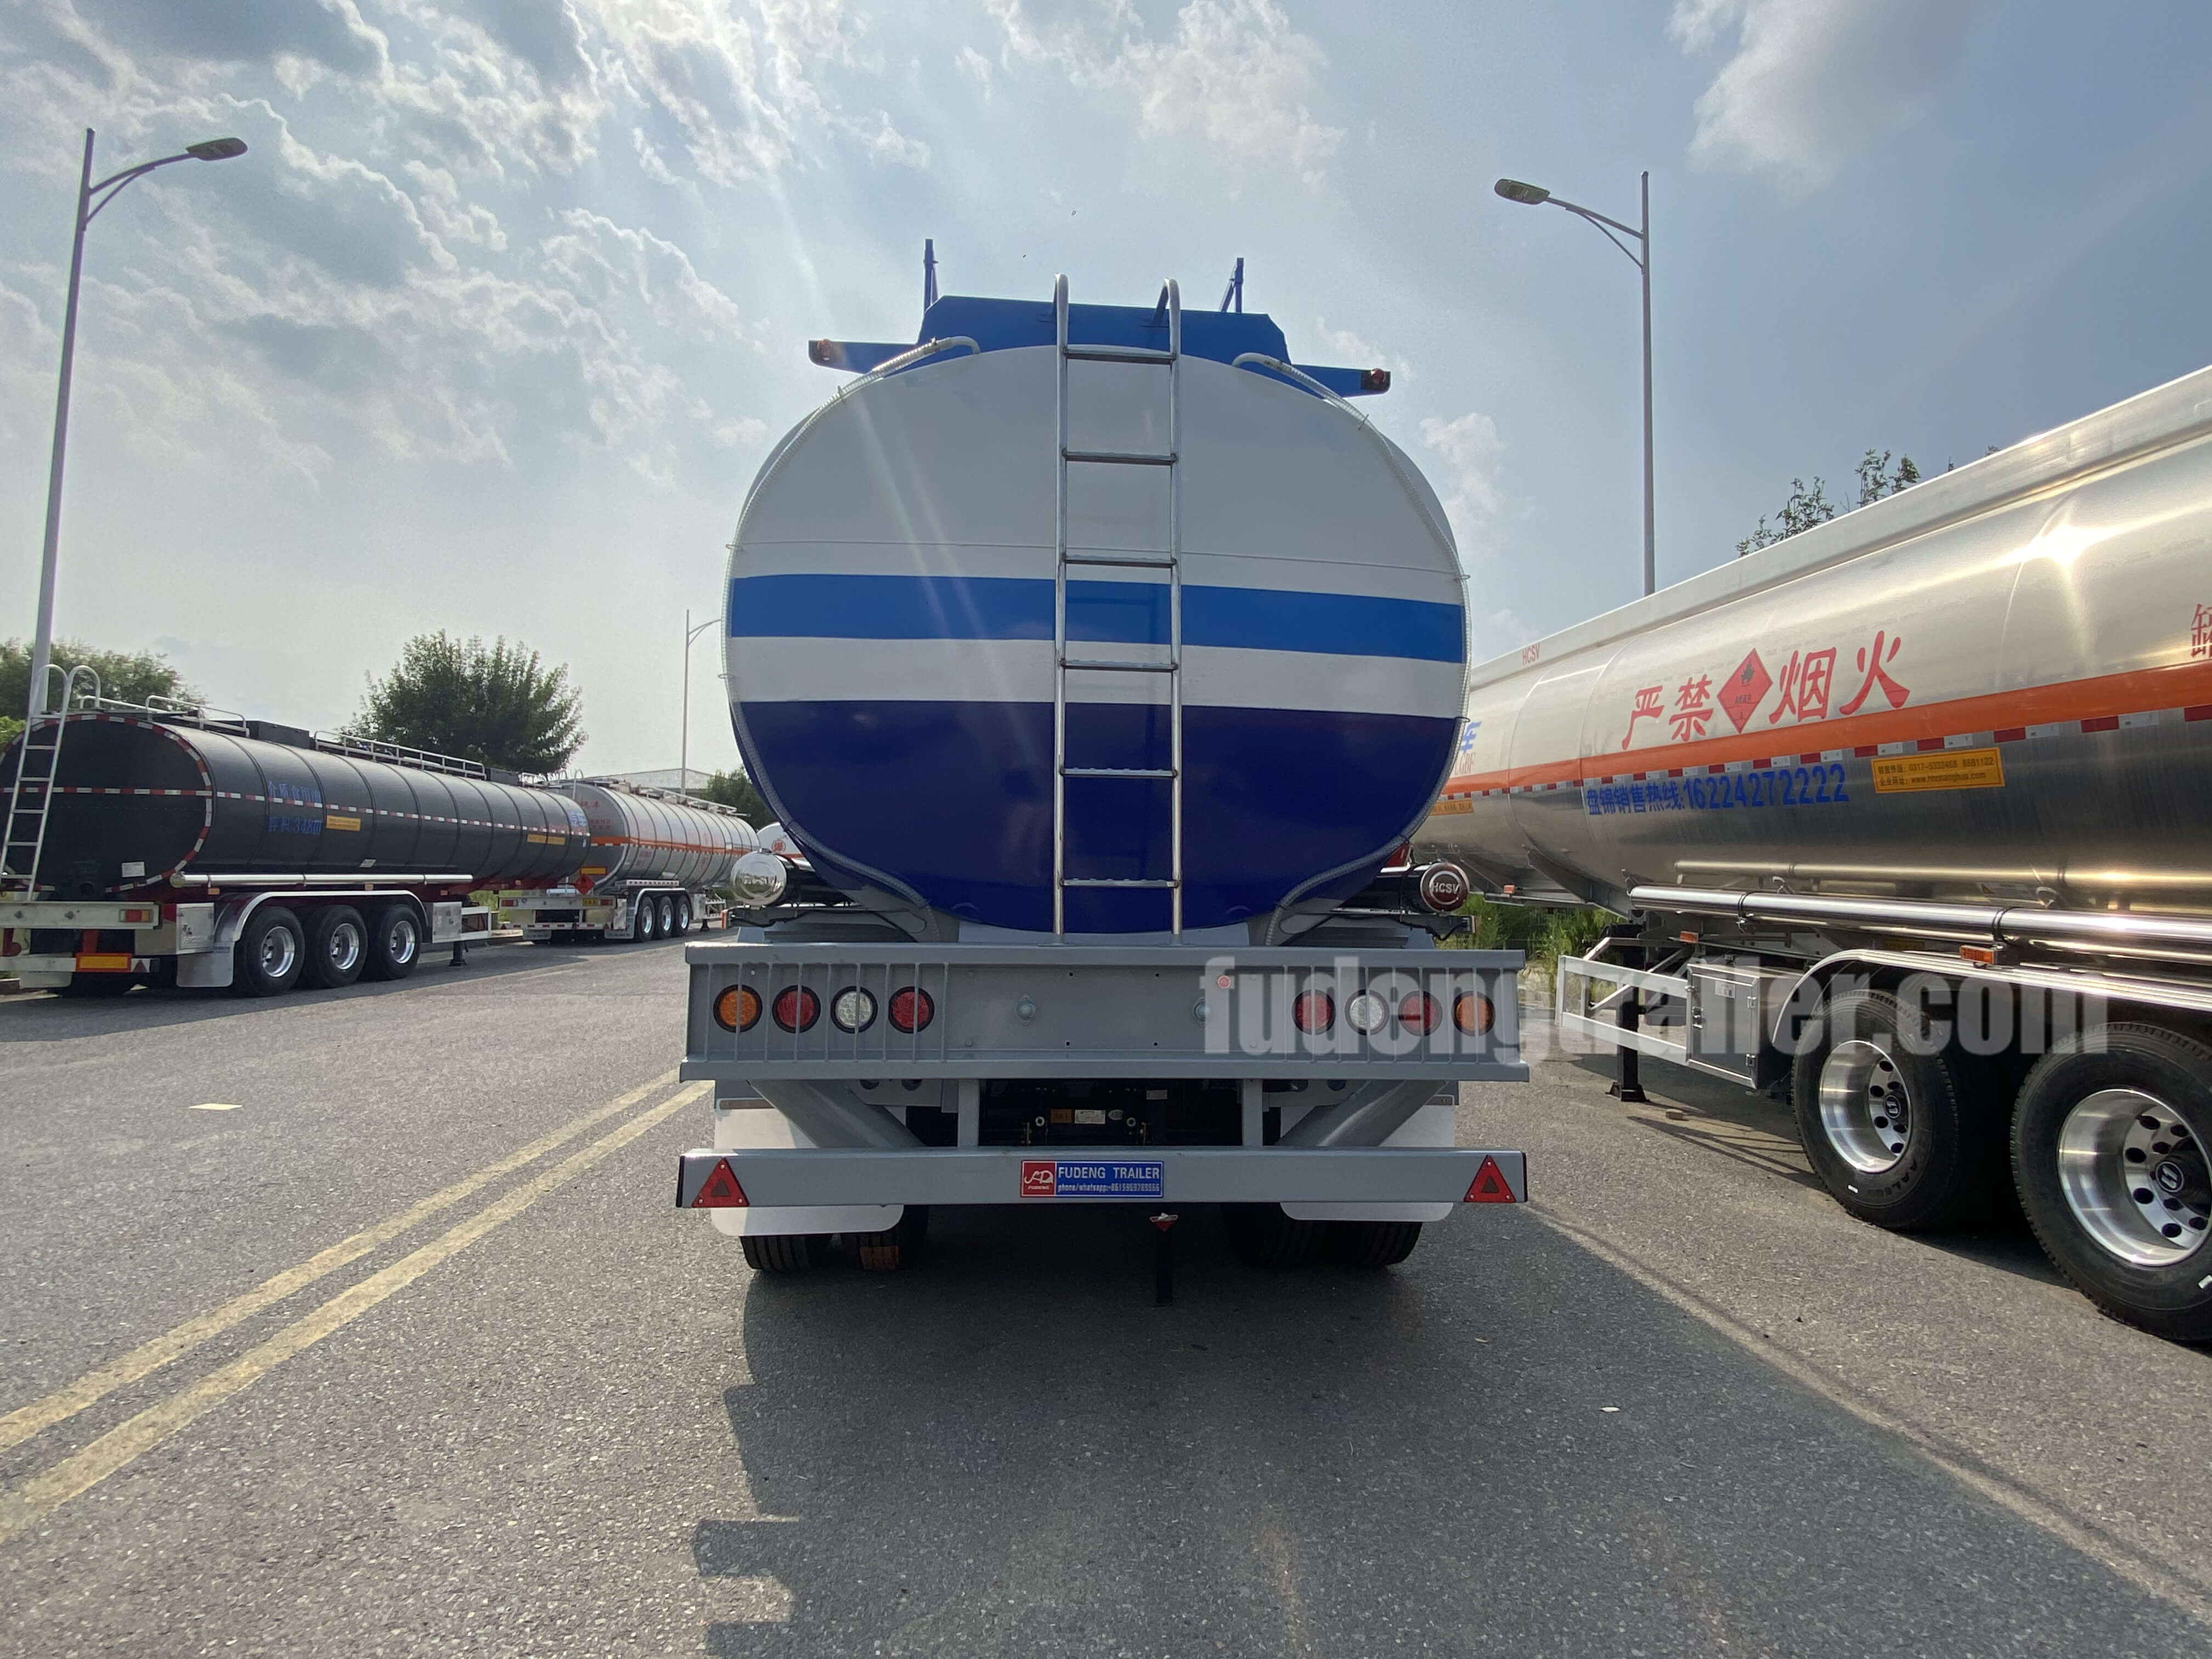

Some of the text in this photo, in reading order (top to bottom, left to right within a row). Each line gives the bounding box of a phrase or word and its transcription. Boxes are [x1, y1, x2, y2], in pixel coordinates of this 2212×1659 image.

[1522, 642, 1540, 666] HCSV
[1622, 630, 1910, 750] 严禁 烟火
[1430, 882, 1460, 894] HCSV
[1058, 1167, 1106, 1179] FUDENG
[1113, 1167, 1159, 1180] TRAILER
